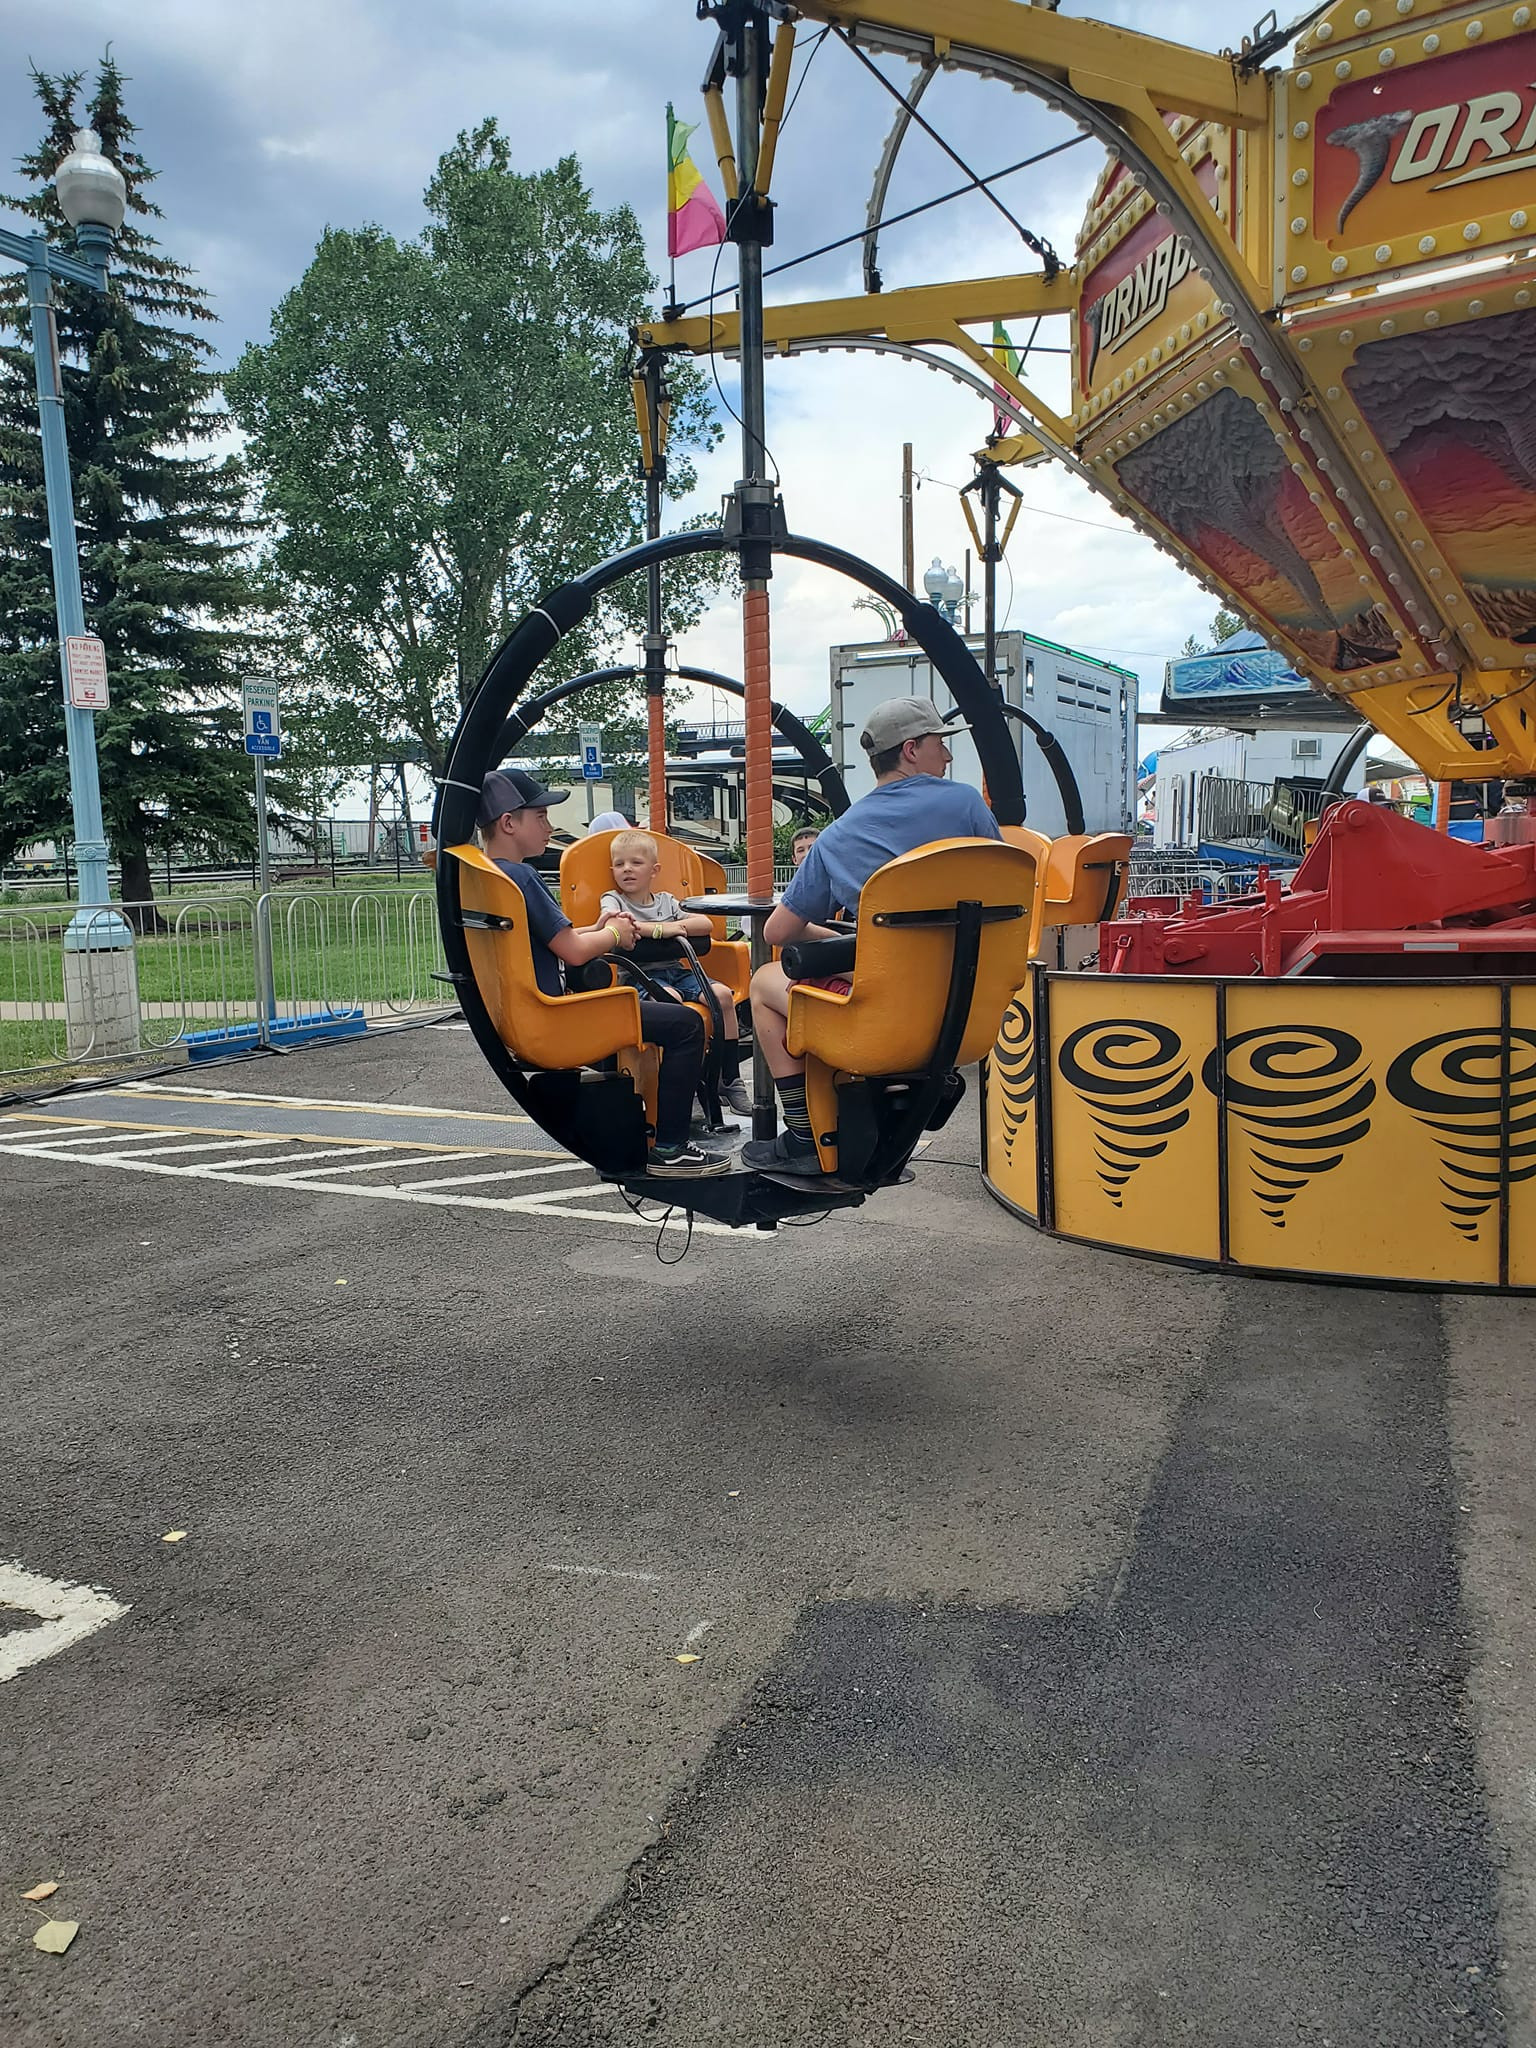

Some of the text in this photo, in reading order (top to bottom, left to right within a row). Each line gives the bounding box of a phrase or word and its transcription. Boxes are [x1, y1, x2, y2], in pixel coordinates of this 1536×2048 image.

[80, 643, 100, 653] PARKING
[245, 684, 276, 696] RESERVED
[247, 697, 275, 708] PARKING
